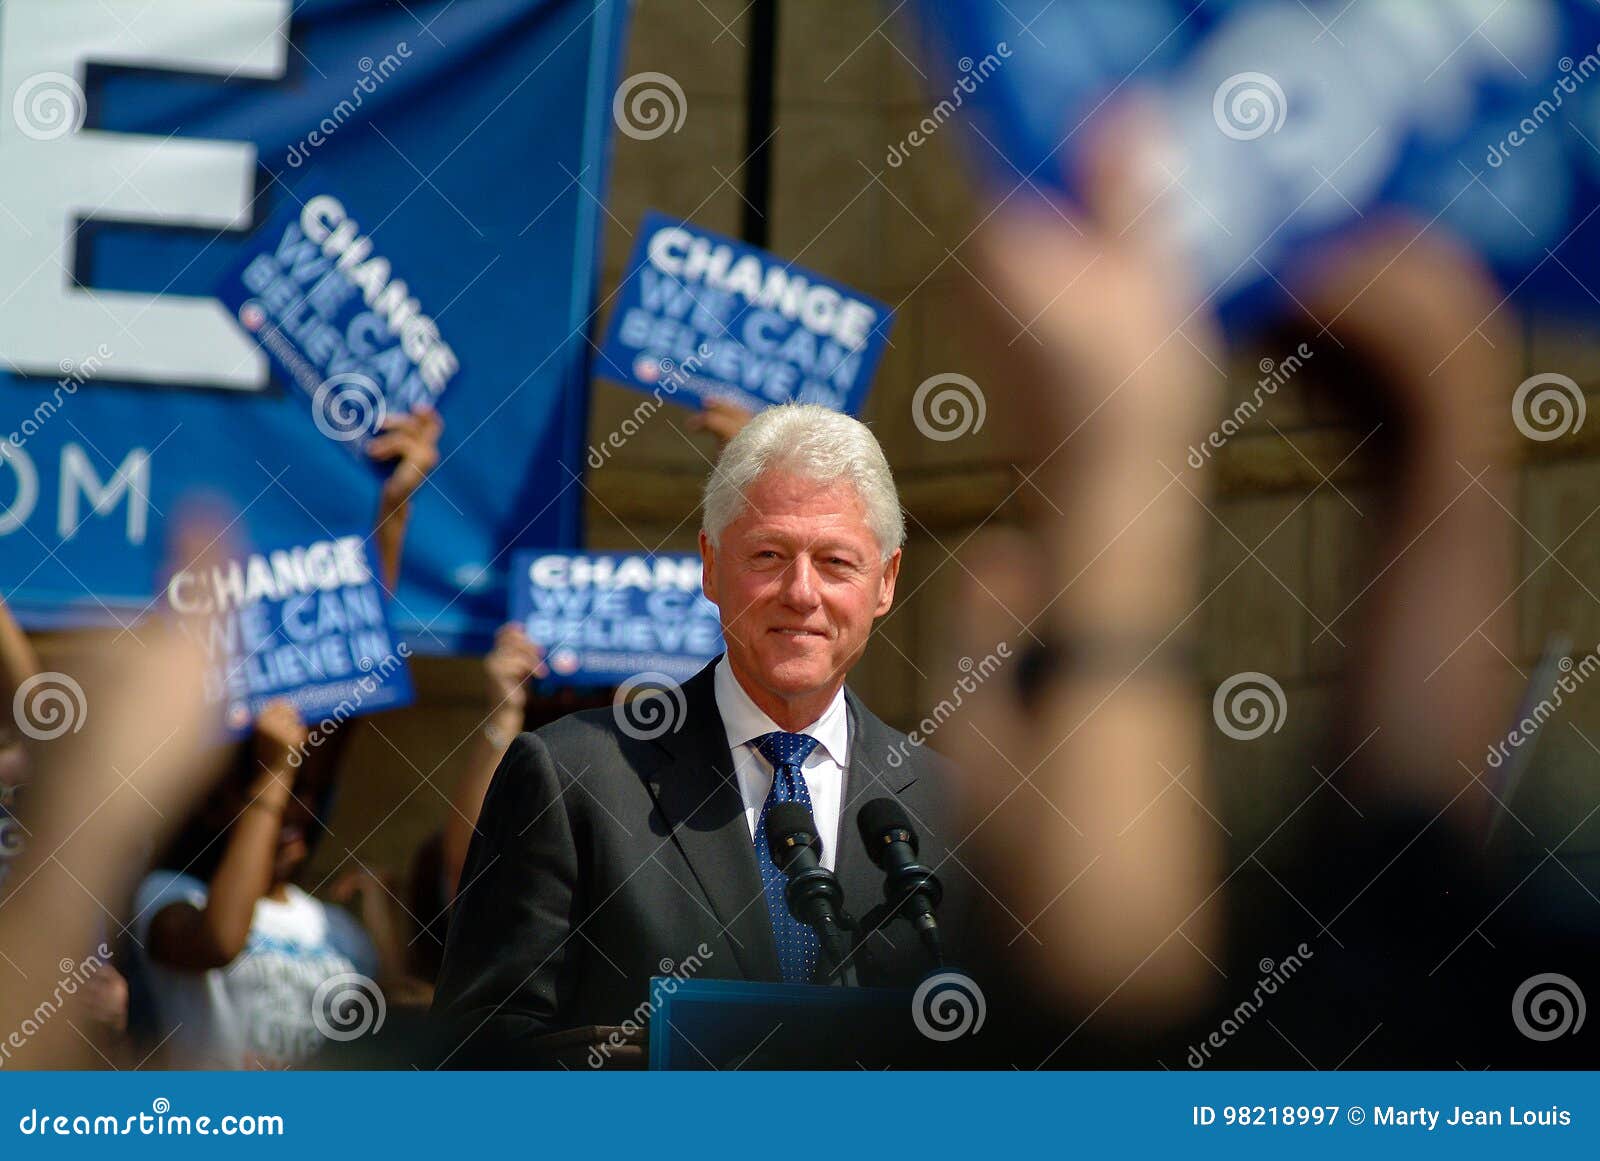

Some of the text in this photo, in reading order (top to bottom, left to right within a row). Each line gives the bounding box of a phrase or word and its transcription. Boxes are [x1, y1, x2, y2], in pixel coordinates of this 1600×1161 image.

[0, 0, 290, 391] E
[275, 221, 357, 325] WE
[301, 194, 459, 397] CHANGE
[648, 227, 877, 351] CHANGE
[619, 307, 798, 402] BELIEVE
[639, 266, 735, 335] WE
[743, 309, 863, 398] CAN
[168, 535, 370, 614] CHANGE
[281, 583, 384, 643] CAN
[530, 587, 633, 621] WE
[350, 629, 393, 670] IN
[526, 609, 720, 655] BELIEVE
